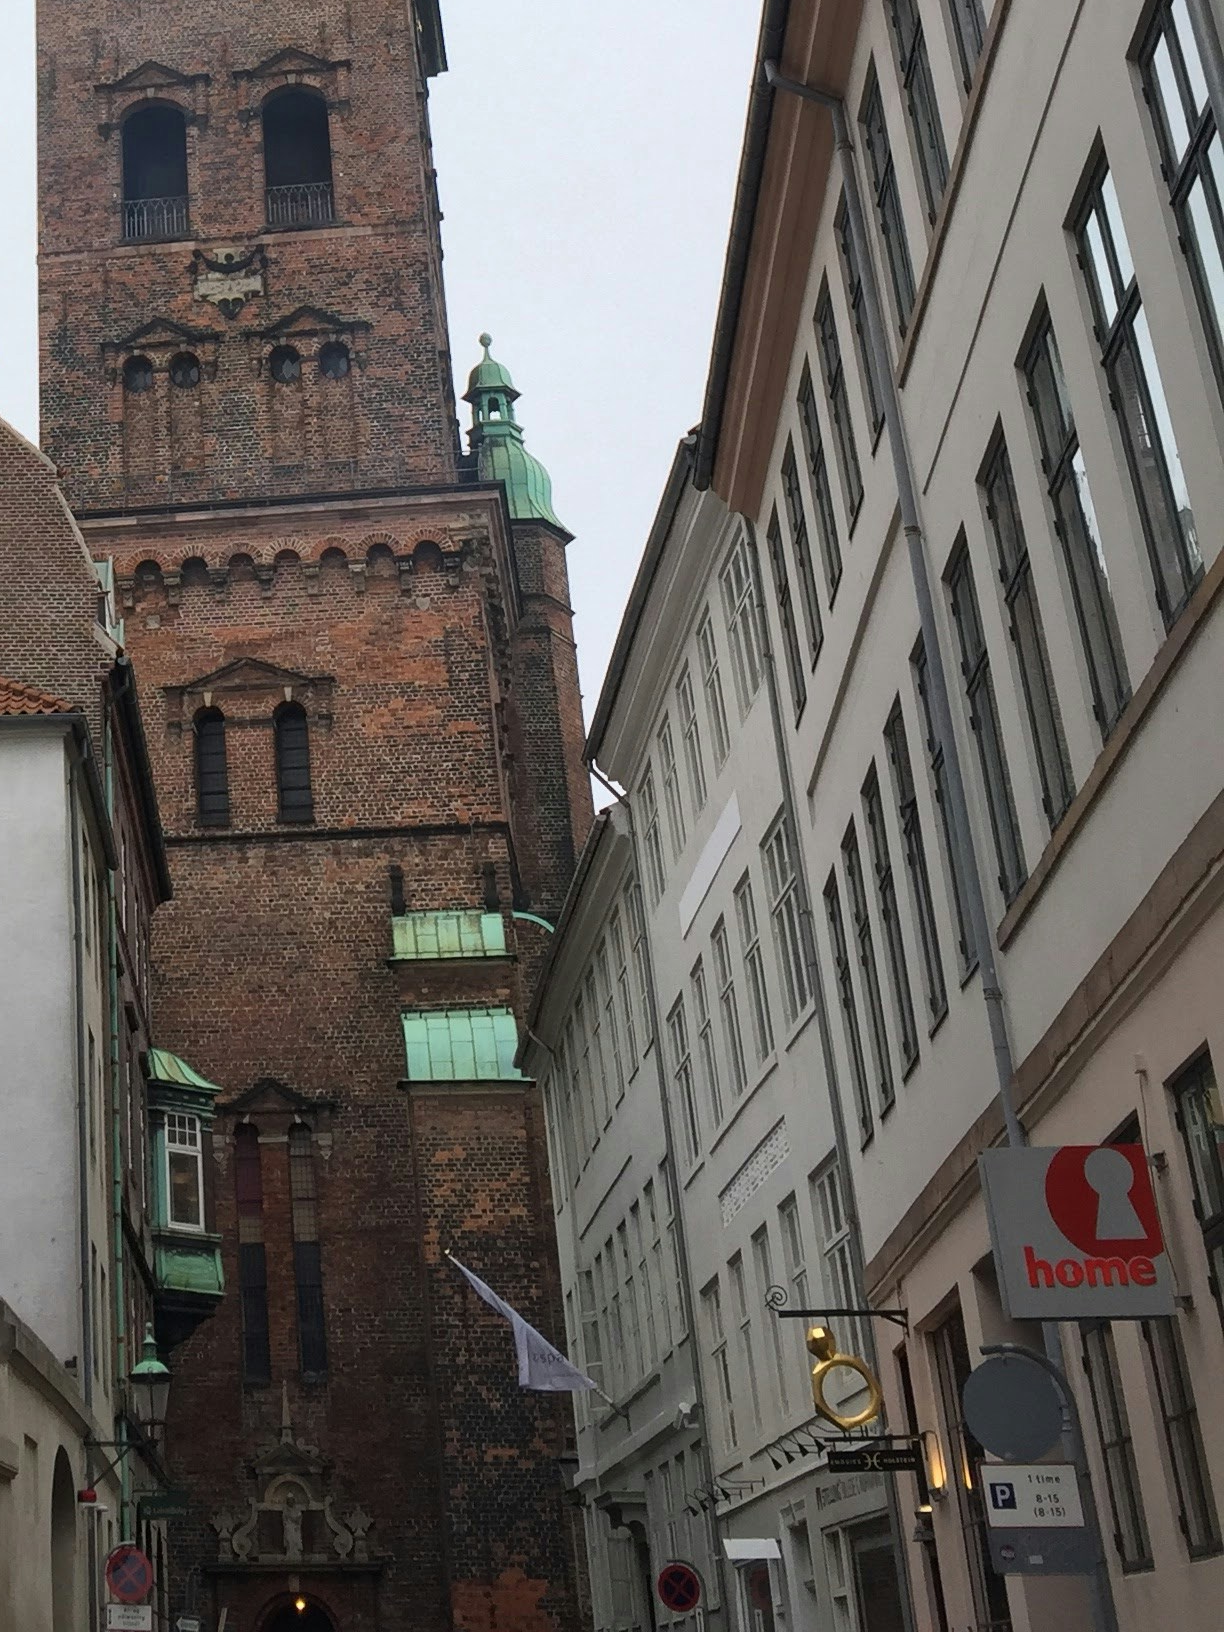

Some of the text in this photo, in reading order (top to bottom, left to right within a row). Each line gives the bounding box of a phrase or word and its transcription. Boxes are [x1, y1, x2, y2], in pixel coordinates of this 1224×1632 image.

[1024, 1245, 1157, 1288] home
[1027, 1474, 1061, 1484] 1 time
[995, 1485, 1011, 1507] P
